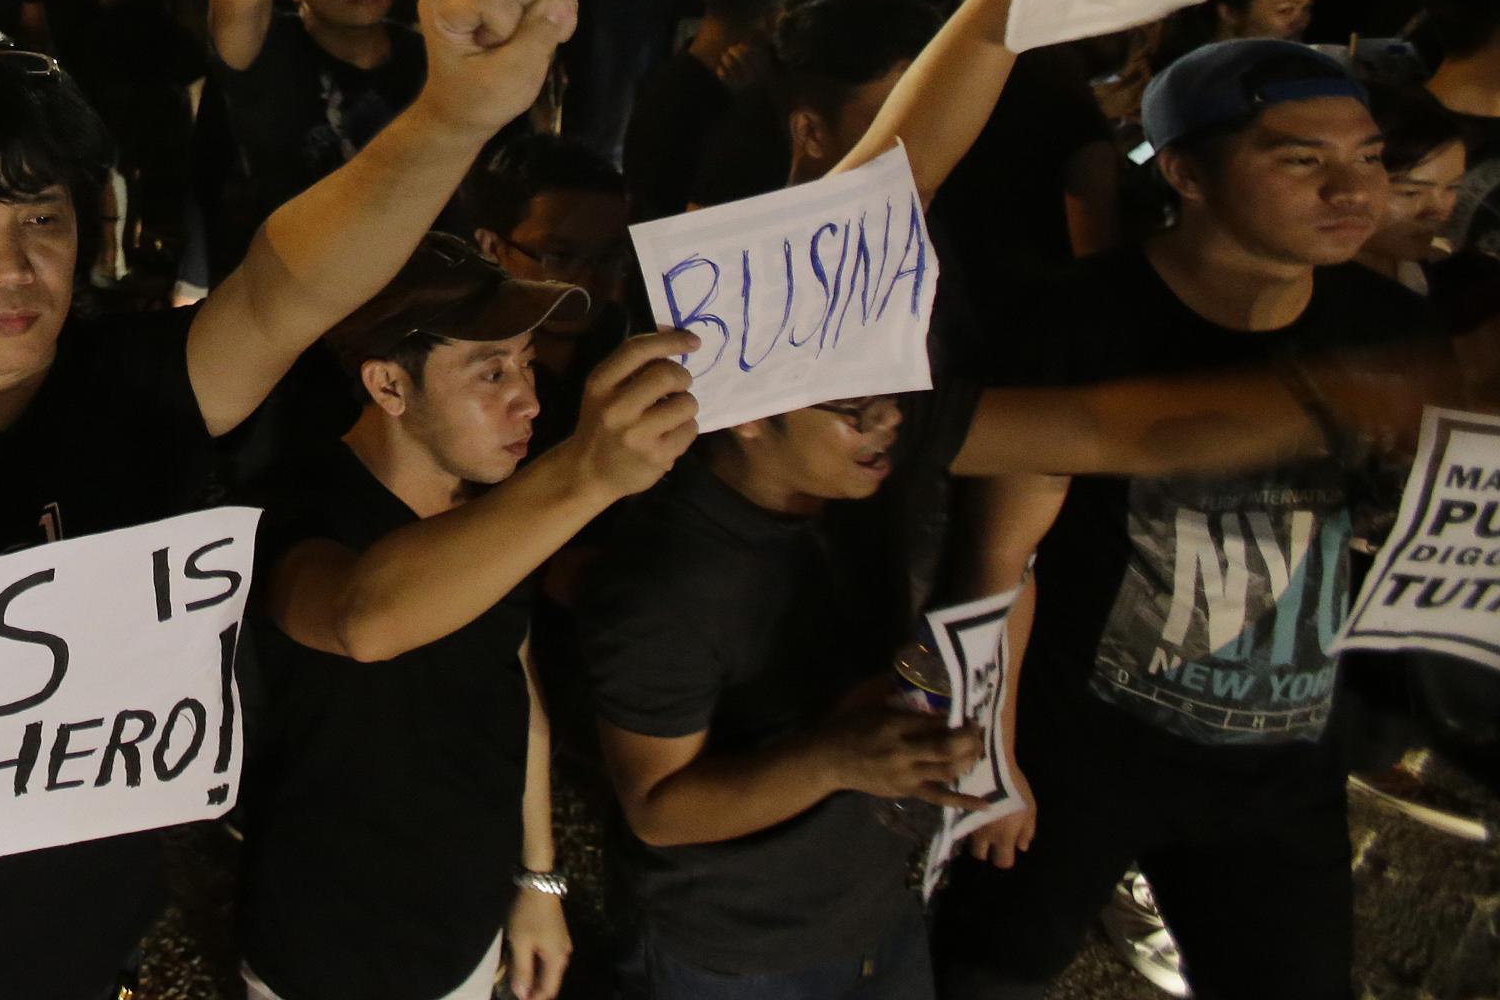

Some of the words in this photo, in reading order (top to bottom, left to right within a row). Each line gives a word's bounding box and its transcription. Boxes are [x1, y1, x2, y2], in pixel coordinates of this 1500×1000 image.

[662, 192, 927, 379] BUSINA
[152, 538, 241, 621] IS
[1148, 646, 1257, 699] NEW
